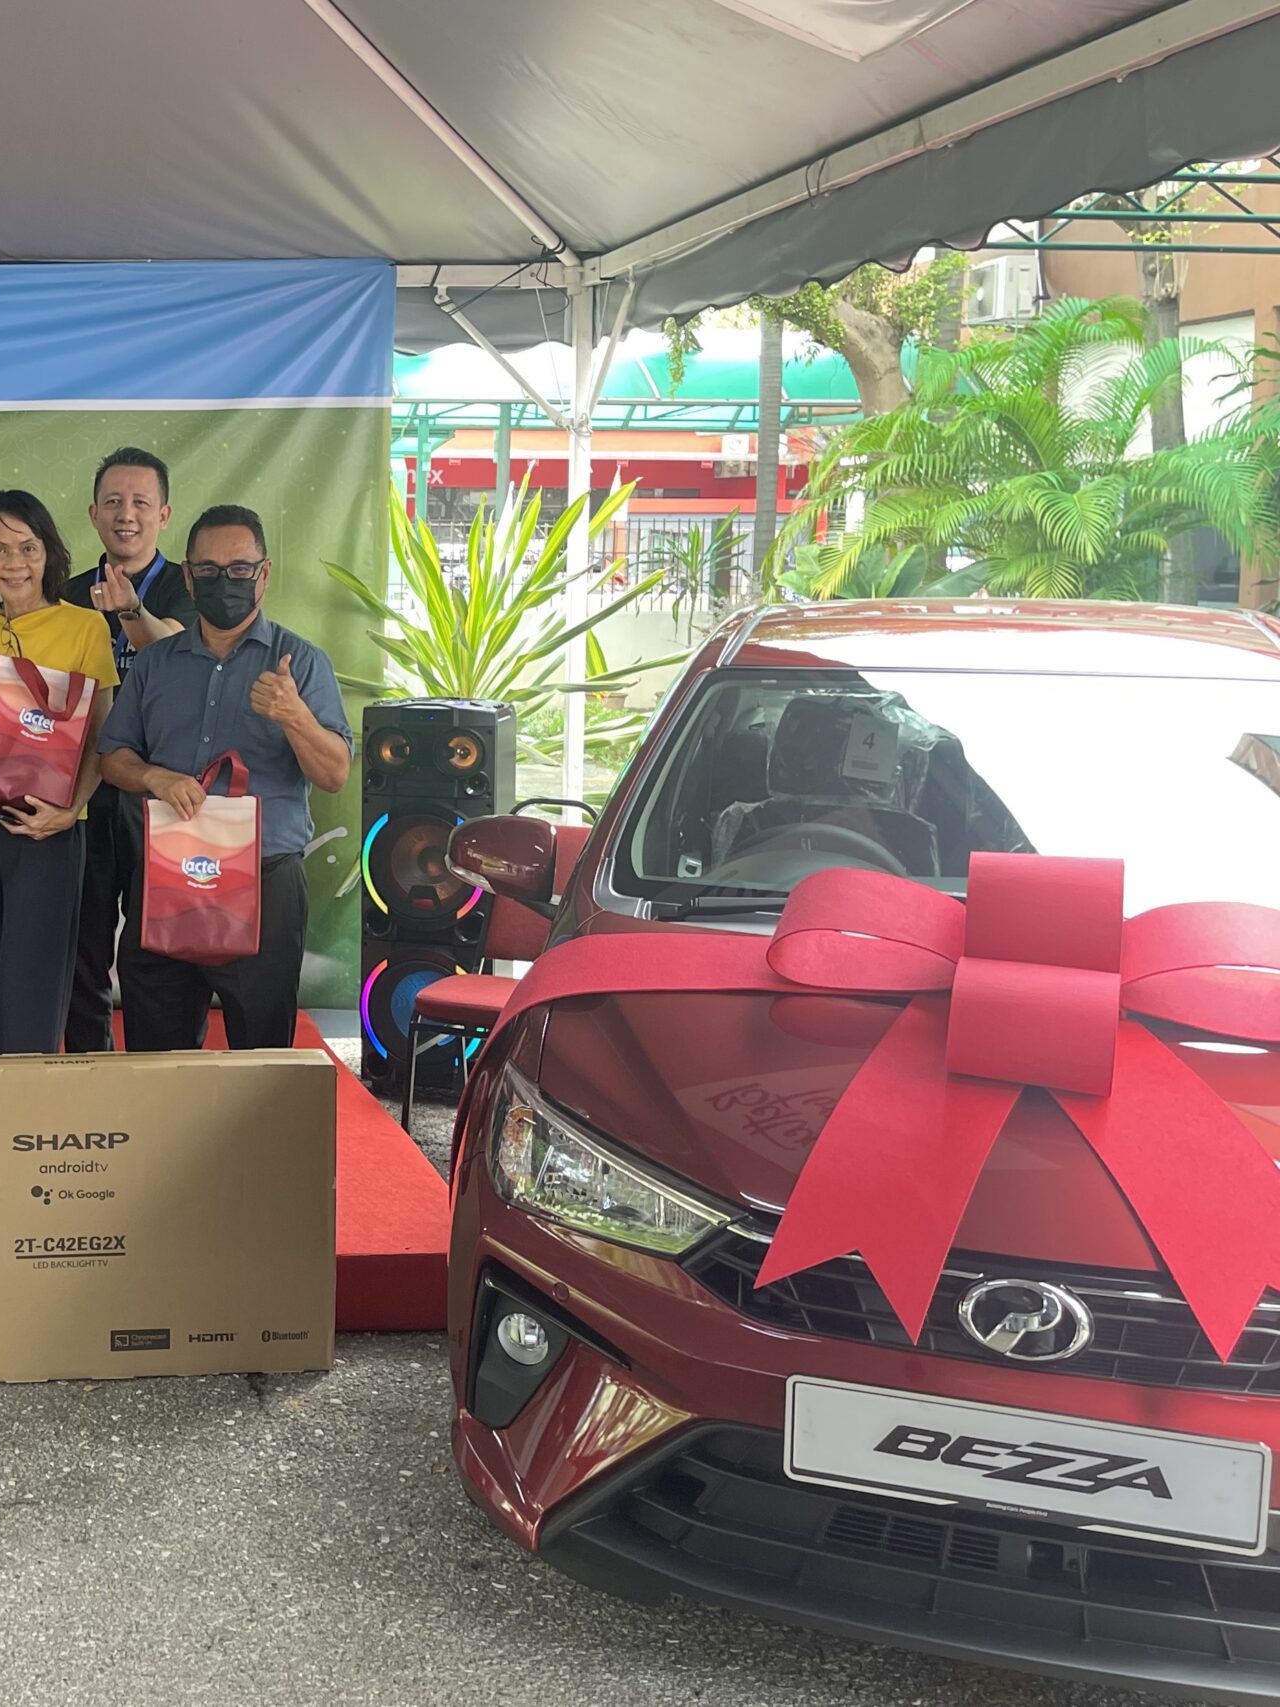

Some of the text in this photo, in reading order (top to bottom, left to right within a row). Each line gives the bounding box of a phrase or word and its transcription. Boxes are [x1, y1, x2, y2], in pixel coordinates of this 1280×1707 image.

[19, 708, 56, 732] lactel
[862, 732, 875, 749] 4
[181, 858, 222, 875] lactel
[12, 1132, 130, 1151] SHARP
[76, 1189, 115, 1201] Google
[14, 1235, 126, 1253] 2T-C42EG2X
[33, 1259, 109, 1269] LED BACKLIGHT TV
[189, 1332, 235, 1343] HDMI
[271, 1331, 309, 1340] Bluetooth
[873, 1425, 1173, 1500] BEZZA
